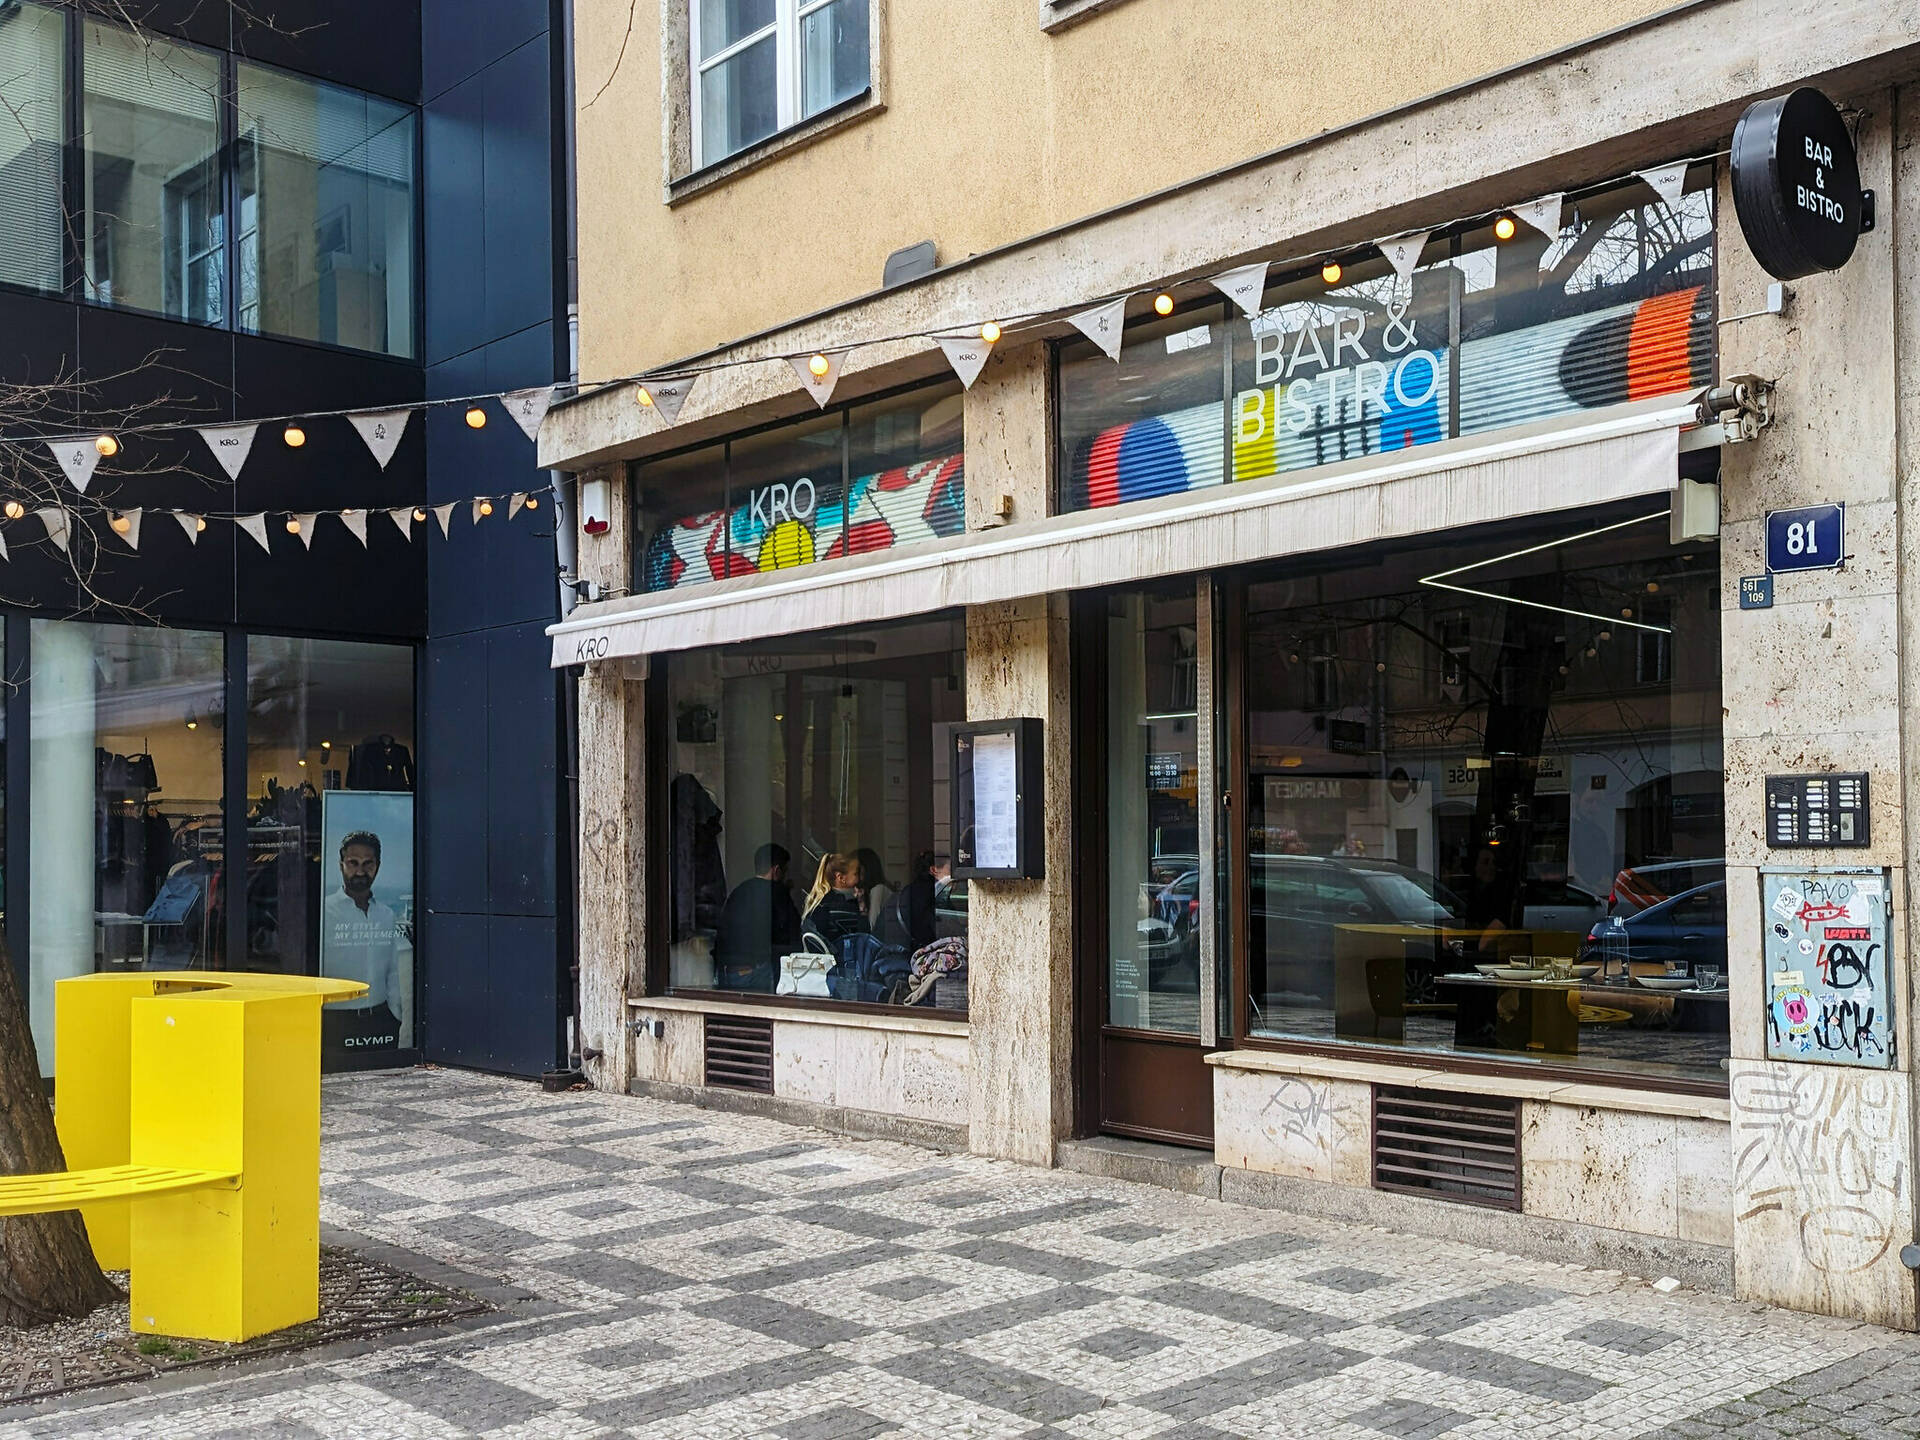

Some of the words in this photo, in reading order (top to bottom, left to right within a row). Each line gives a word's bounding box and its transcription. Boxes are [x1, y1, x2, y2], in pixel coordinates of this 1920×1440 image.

[1804, 135, 1834, 170] BAR
[1815, 166, 1825, 190] &
[1796, 184, 1845, 224] BISTRO
[1255, 307, 1371, 386] BAR
[1382, 294, 1420, 354] &
[958, 353, 978, 362] KRO
[658, 387, 678, 397] KRO
[1236, 349, 1441, 445] BISTRO
[219, 437, 240, 447] KRO
[750, 476, 817, 530] KRO
[1786, 519, 1819, 556] 81
[1747, 592, 1765, 604] 109
[575, 635, 610, 662] KRO
[344, 1035, 394, 1047] OLYMP
